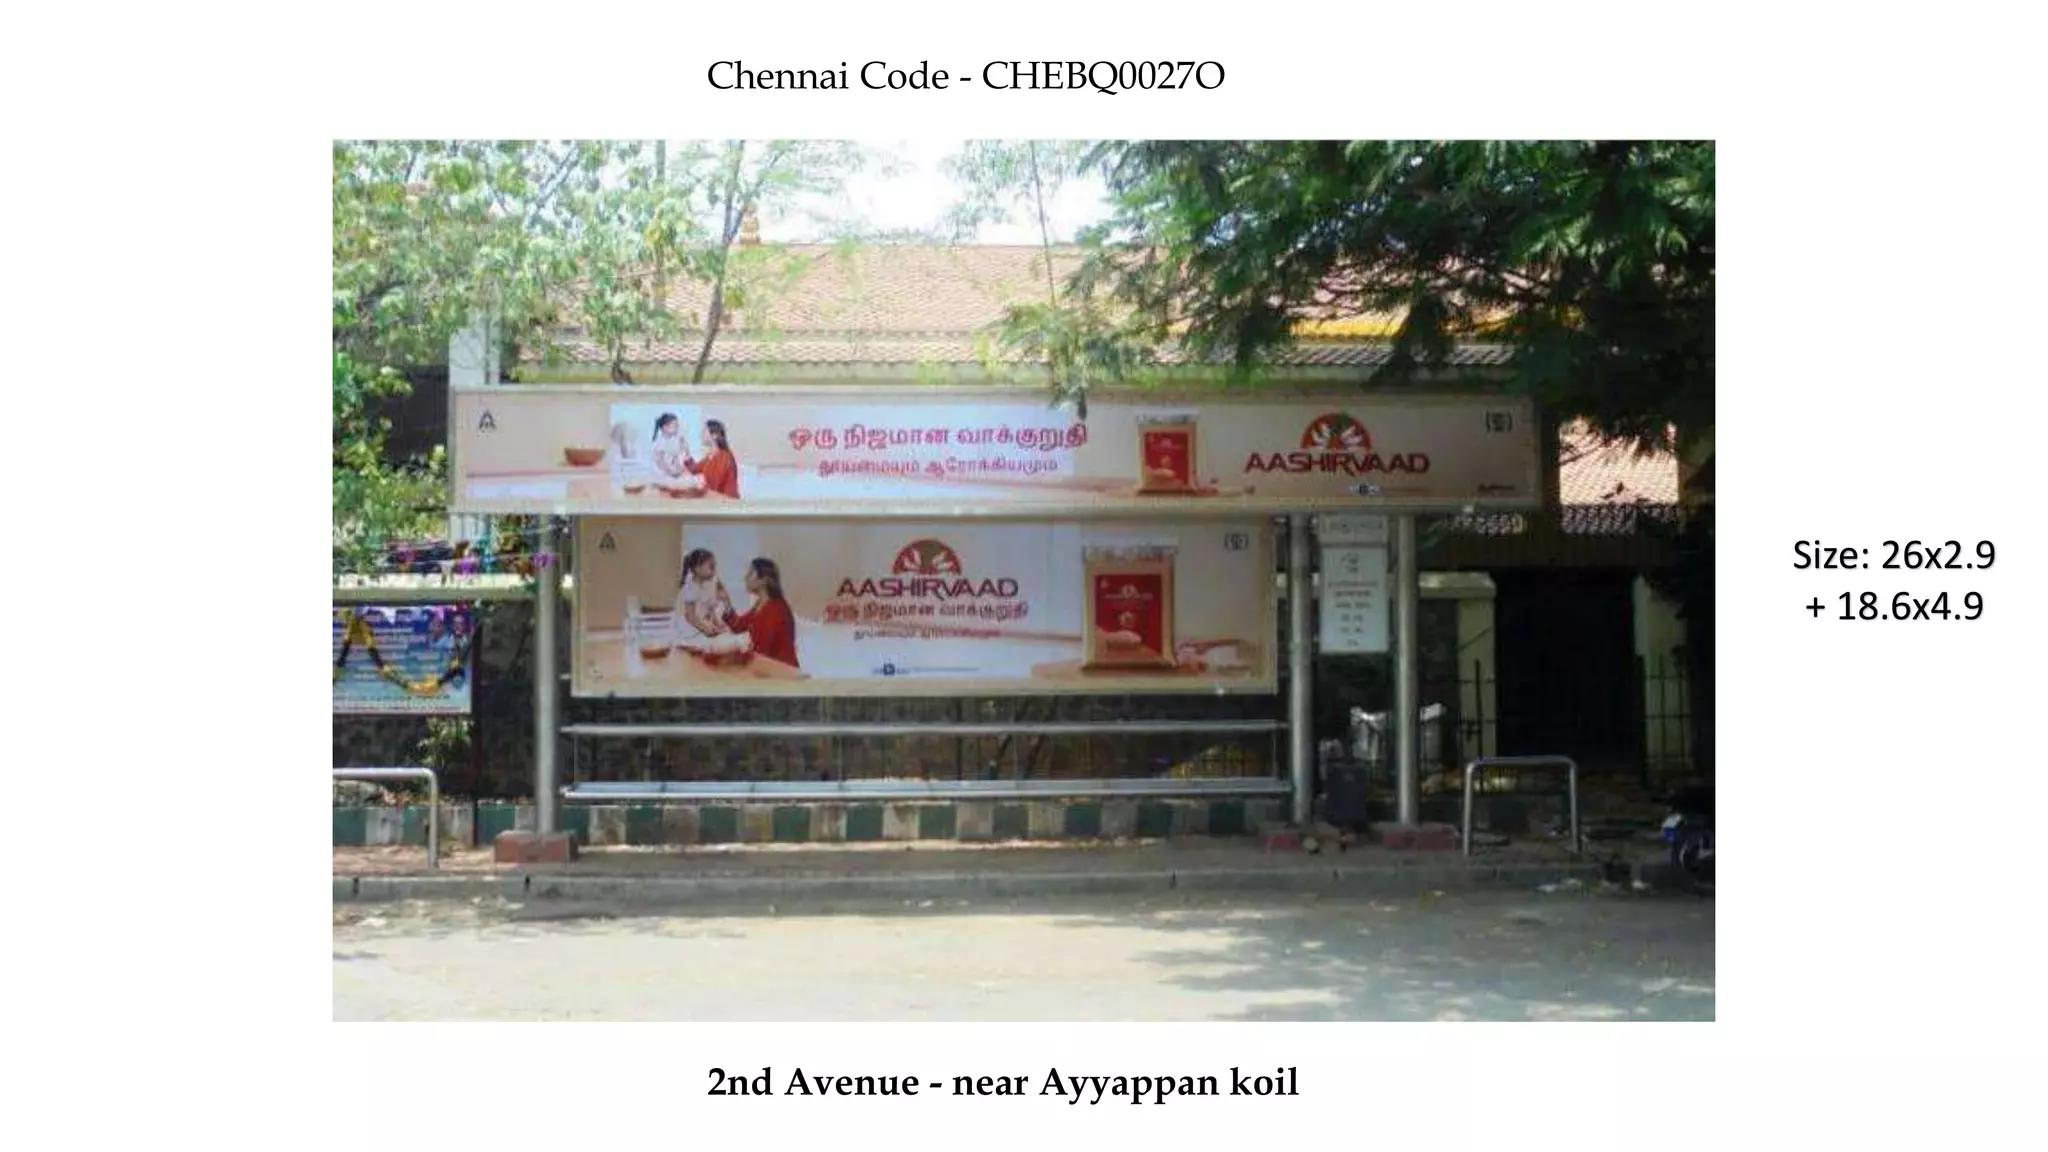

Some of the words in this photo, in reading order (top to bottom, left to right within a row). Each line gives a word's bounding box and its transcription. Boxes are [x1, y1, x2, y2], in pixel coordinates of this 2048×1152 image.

[788, 426, 838, 449] ஒரு
[843, 423, 949, 450] நிஜமான
[957, 423, 1088, 451] வாக்குறுதி
[1244, 452, 1431, 476] AASHIRVAAD
[837, 577, 1019, 601] AASHIRVAAD
